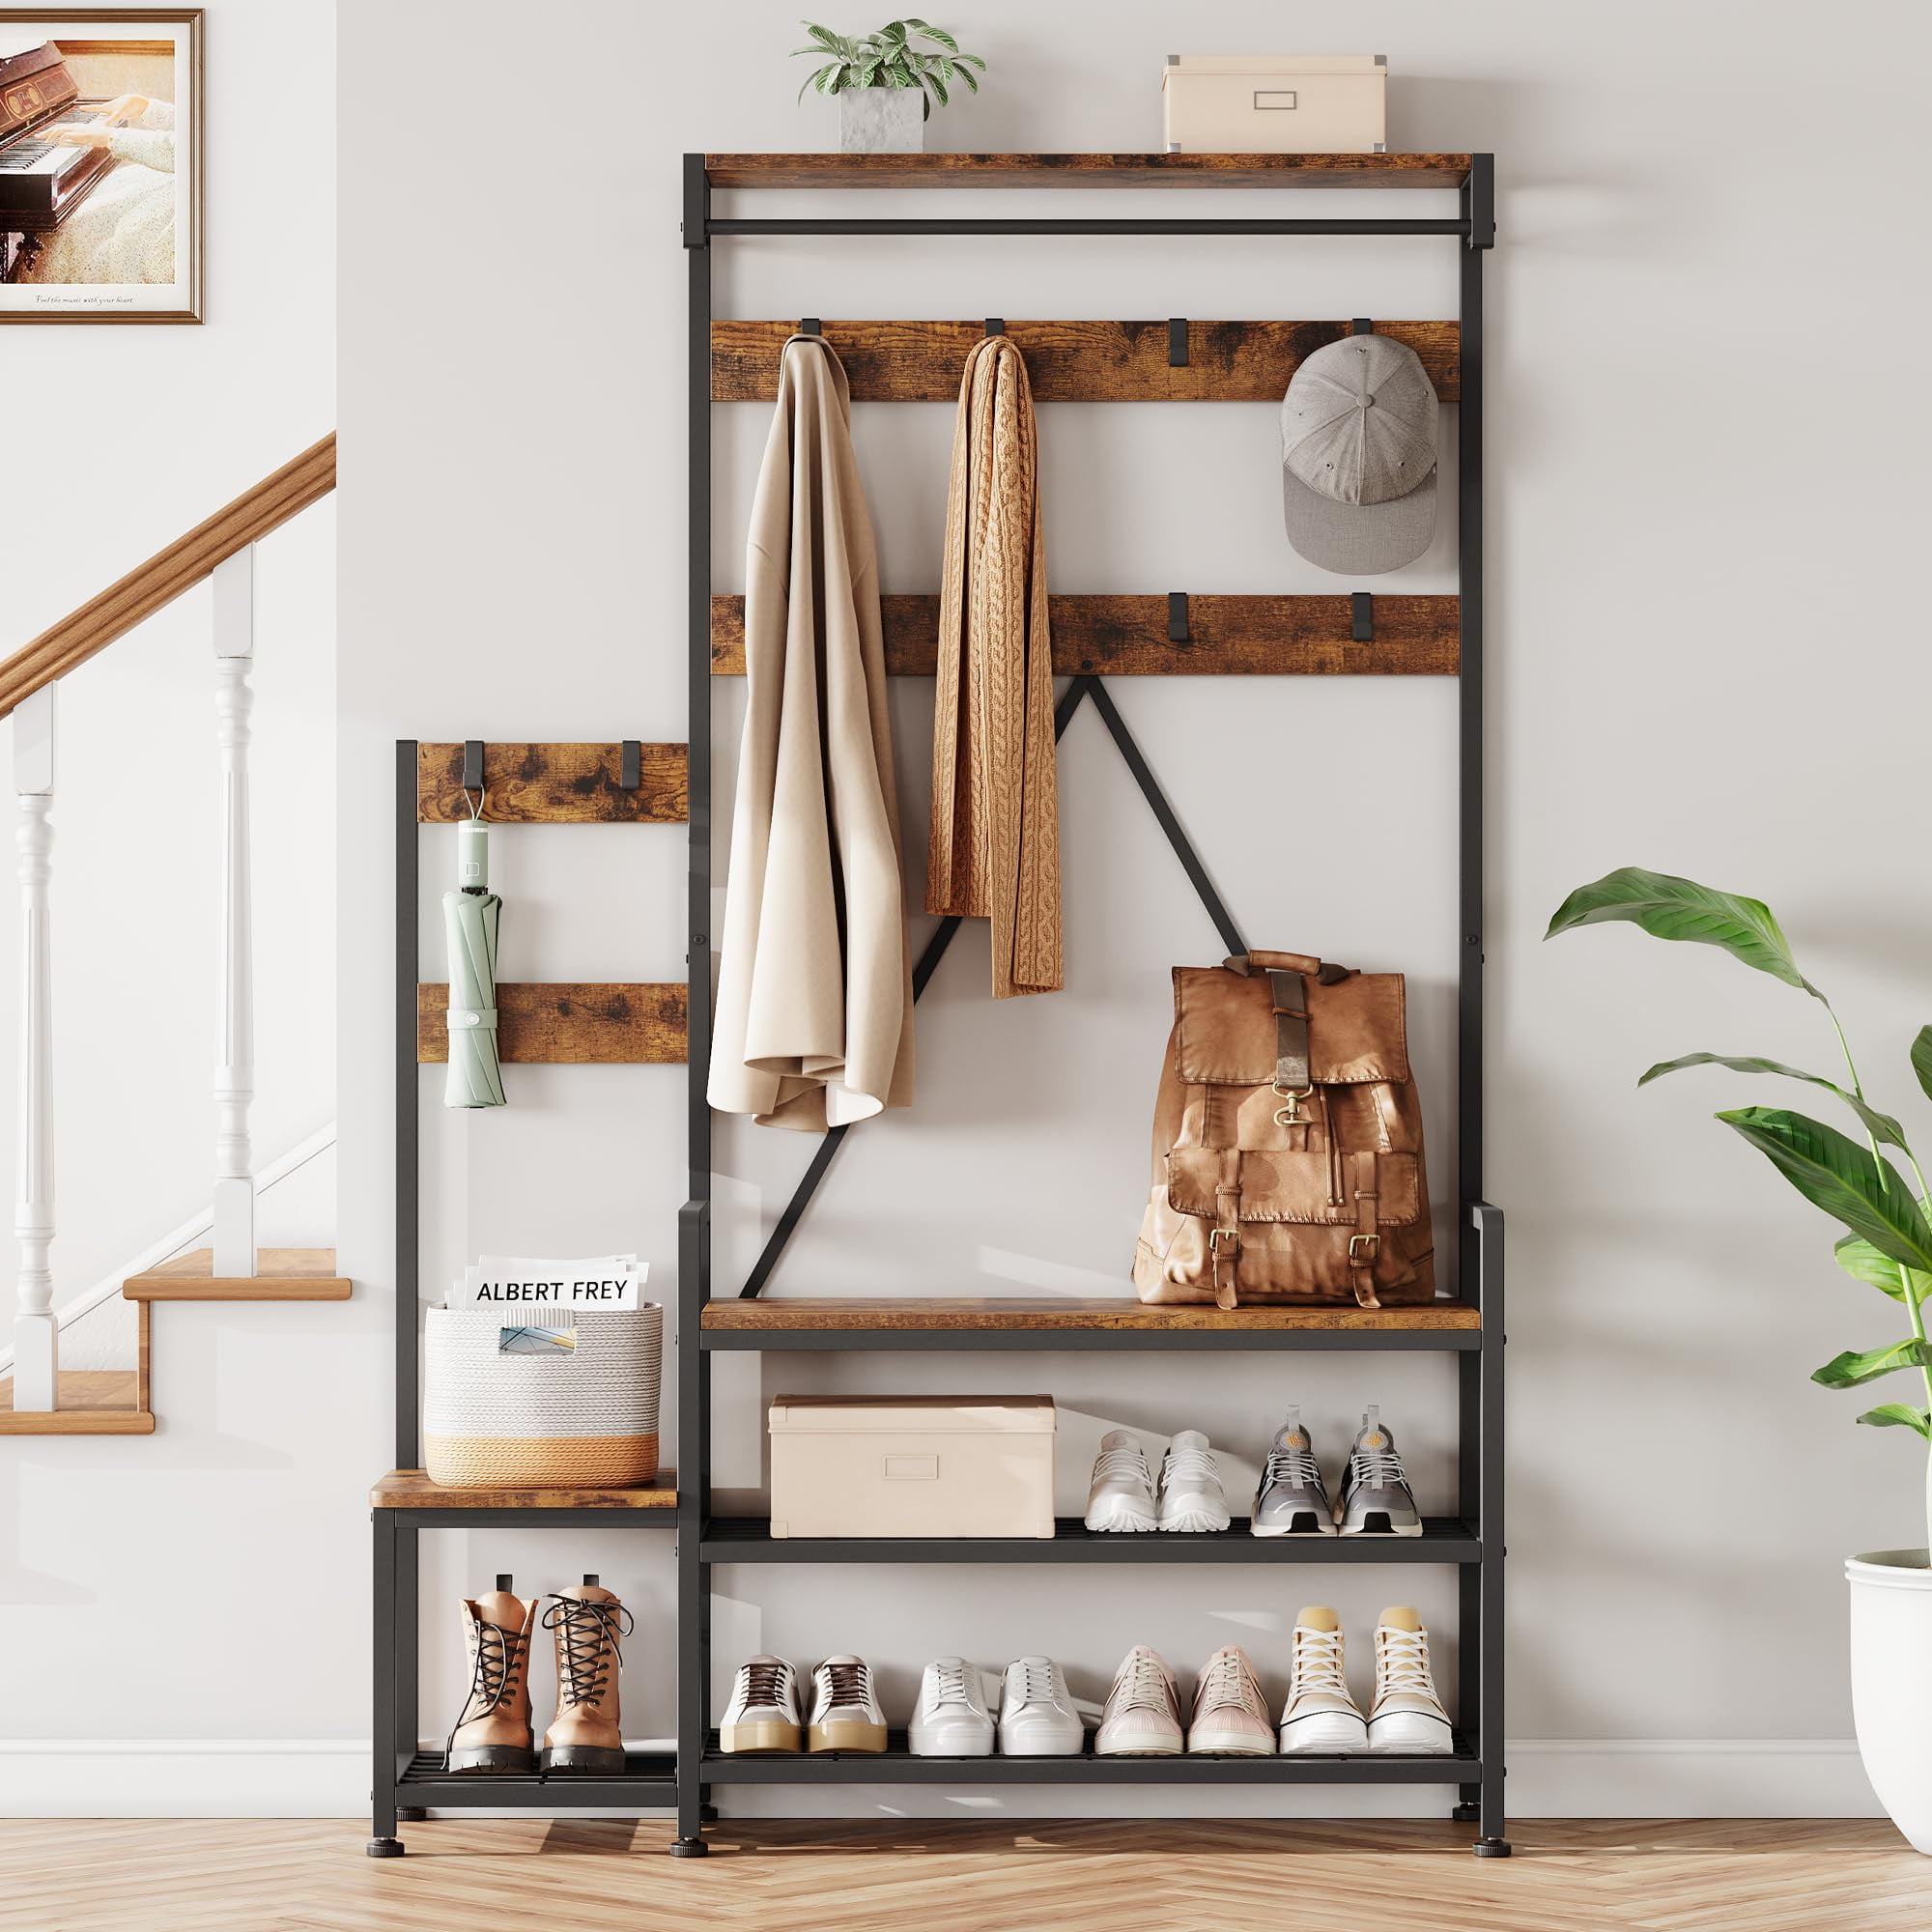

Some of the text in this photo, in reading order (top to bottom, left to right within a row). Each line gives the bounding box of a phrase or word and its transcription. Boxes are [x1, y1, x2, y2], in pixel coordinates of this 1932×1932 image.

[98, 298, 115, 307] your
[476, 1279, 628, 1301] ALBERT FREY
